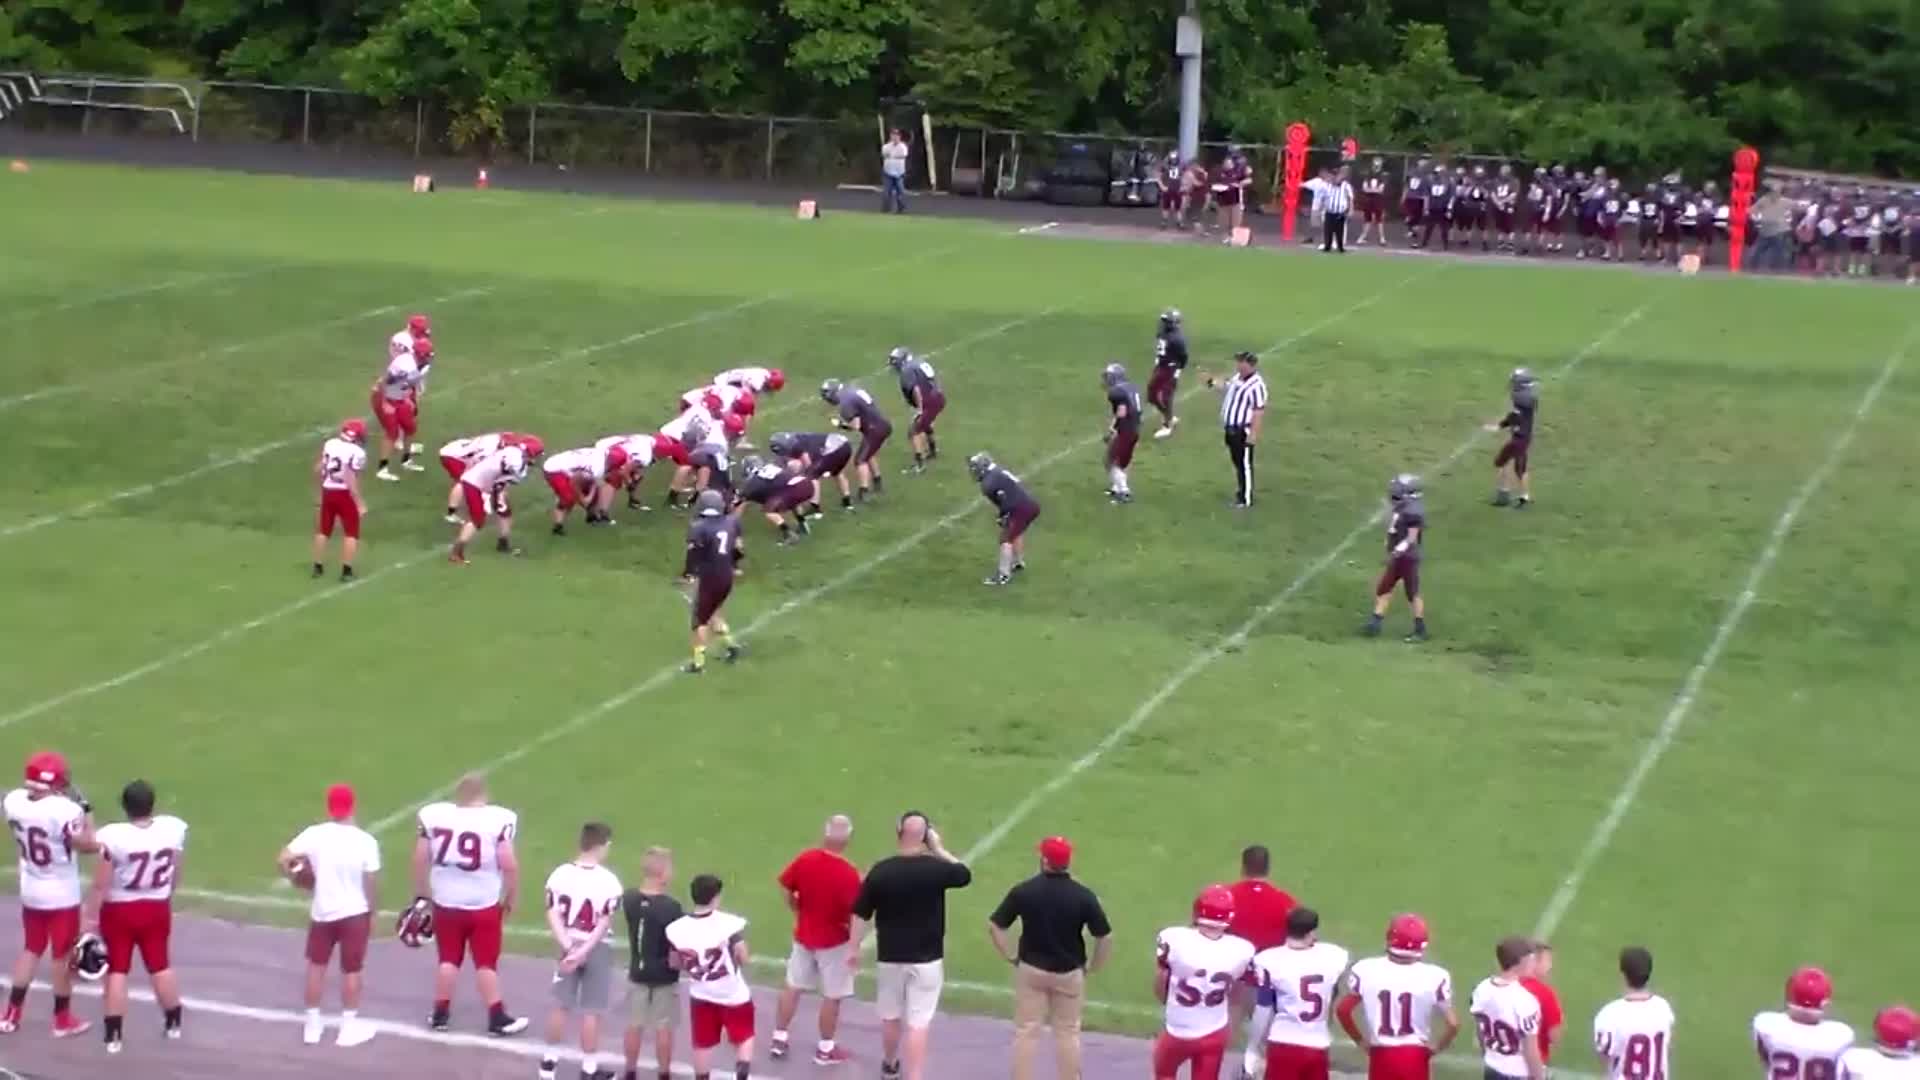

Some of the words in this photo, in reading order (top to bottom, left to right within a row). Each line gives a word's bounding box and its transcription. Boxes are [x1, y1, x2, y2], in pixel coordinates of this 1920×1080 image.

[125, 848, 175, 890] 72
[432, 826, 481, 872] 79
[1299, 974, 1323, 1022] 5
[1377, 989, 1415, 1036] 11
[1623, 1032, 1665, 1080] 81
